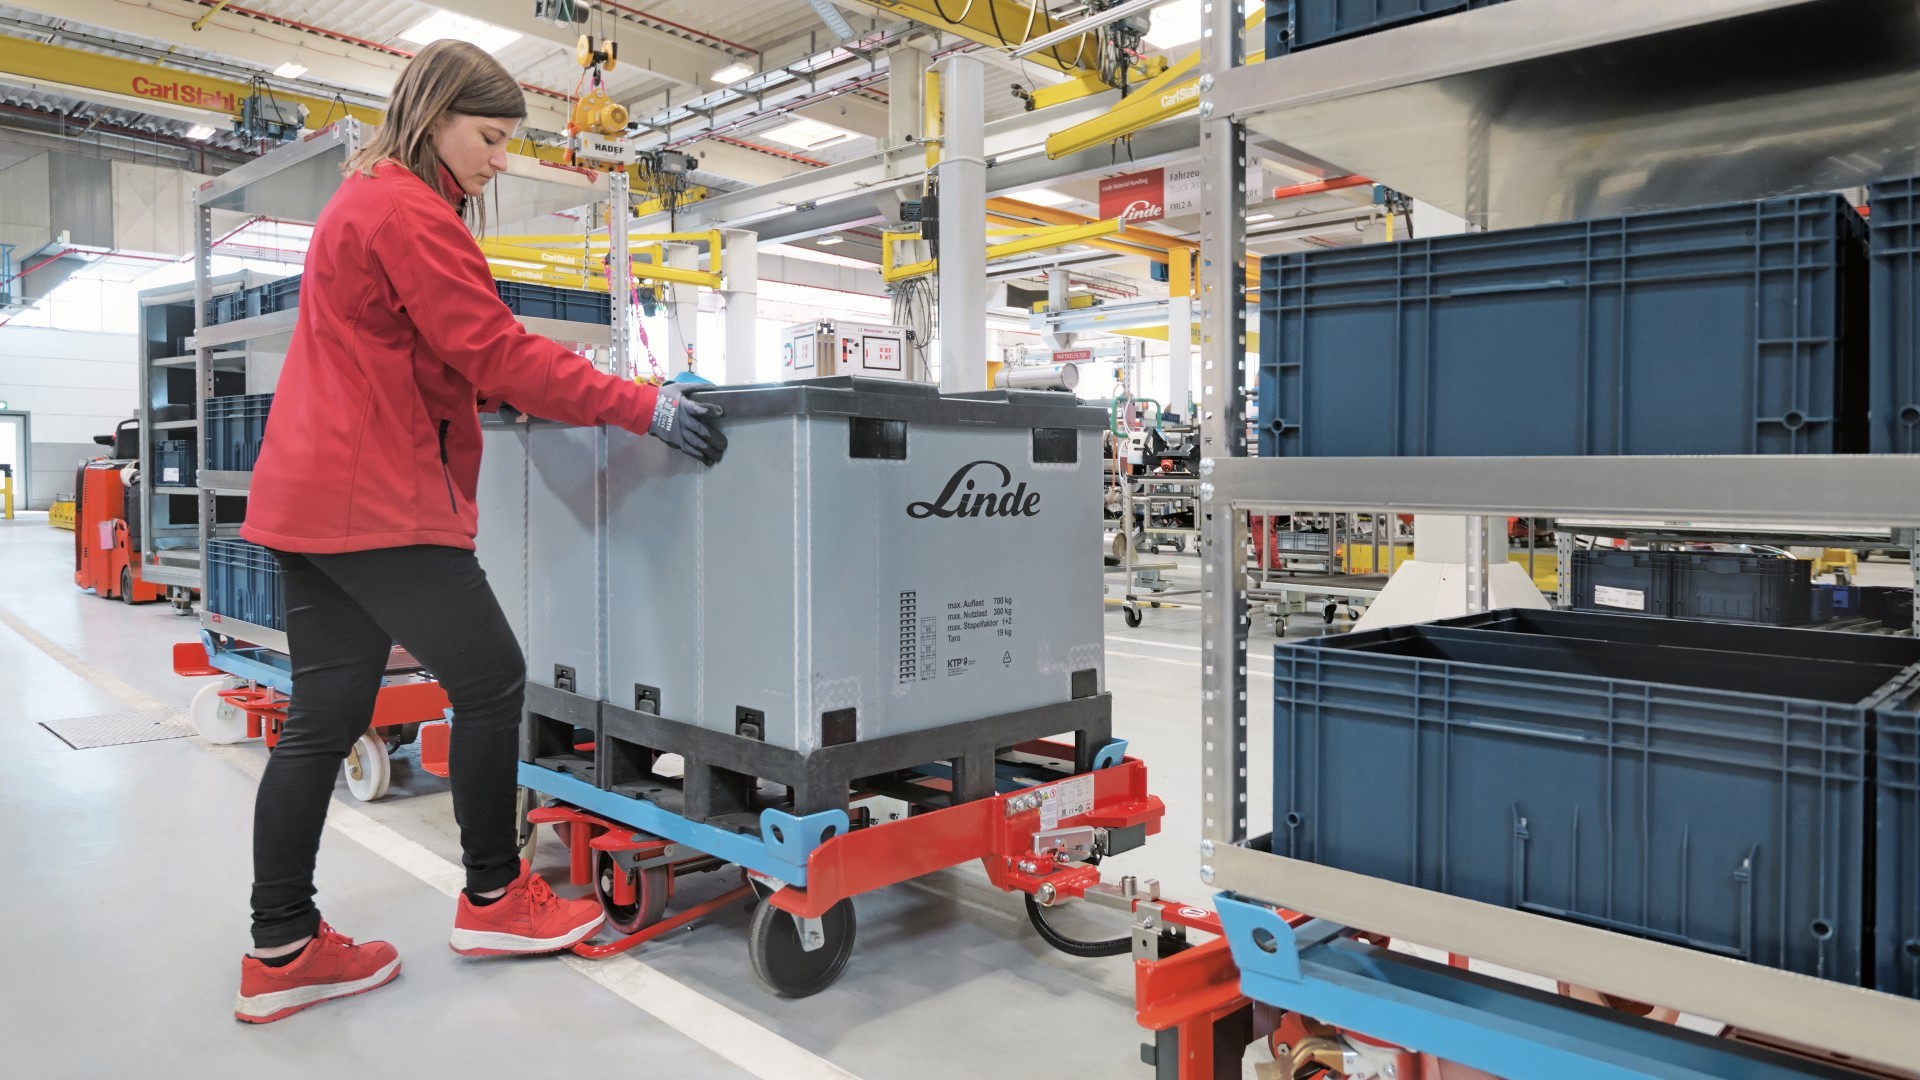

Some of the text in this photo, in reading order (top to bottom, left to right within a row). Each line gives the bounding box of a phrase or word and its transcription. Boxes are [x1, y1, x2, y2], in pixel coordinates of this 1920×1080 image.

[132, 76, 235, 112] Carl Stahl
[1179, 83, 1200, 101] Stah
[595, 143, 625, 154] HADEF
[1170, 170, 1200, 181] Fahrzeu
[1121, 200, 1162, 220] Linde
[1187, 200, 1192, 208] A
[906, 460, 1041, 519] Linde
[947, 596, 1012, 610] max. Auflast 700 kg
[963, 610, 988, 619] Nutzlast
[993, 607, 1004, 616] 300
[1004, 607, 1012, 616] kg
[963, 620, 999, 630] Stapelfaktor
[1001, 617, 1012, 625] 1+2
[947, 628, 1012, 643] Tara 19 kg
[947, 658, 962, 668] KTP
